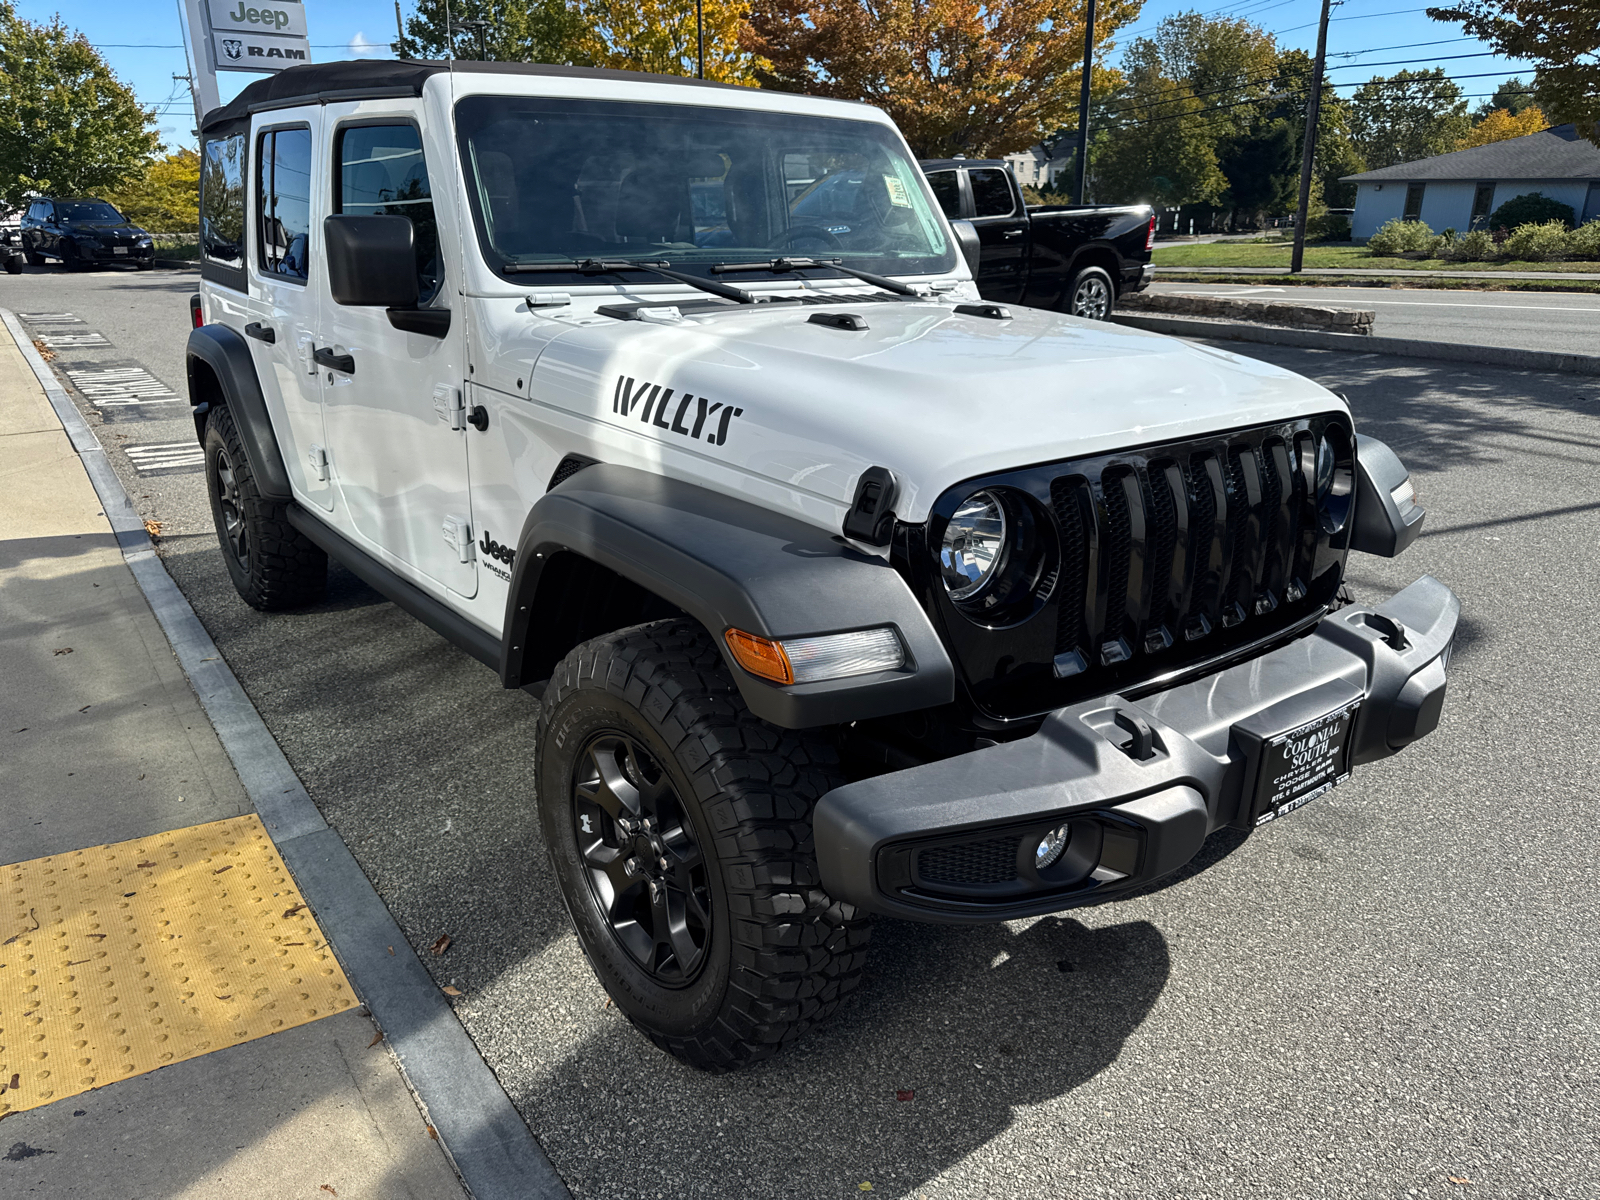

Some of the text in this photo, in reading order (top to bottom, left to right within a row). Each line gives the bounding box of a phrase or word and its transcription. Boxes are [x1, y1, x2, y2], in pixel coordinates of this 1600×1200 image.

[229, 1, 289, 30] Jeep
[247, 46, 306, 60] RAM
[613, 374, 744, 447] WILLYS
[1283, 721, 1340, 759] COLONIAL
[1290, 739, 1330, 770] SOUTH
[1273, 756, 1322, 784] CHRYSLER
[1326, 745, 1340, 757] Jeep
[1278, 758, 1333, 790] DODGE RAM
[1285, 789, 1291, 797] 6
